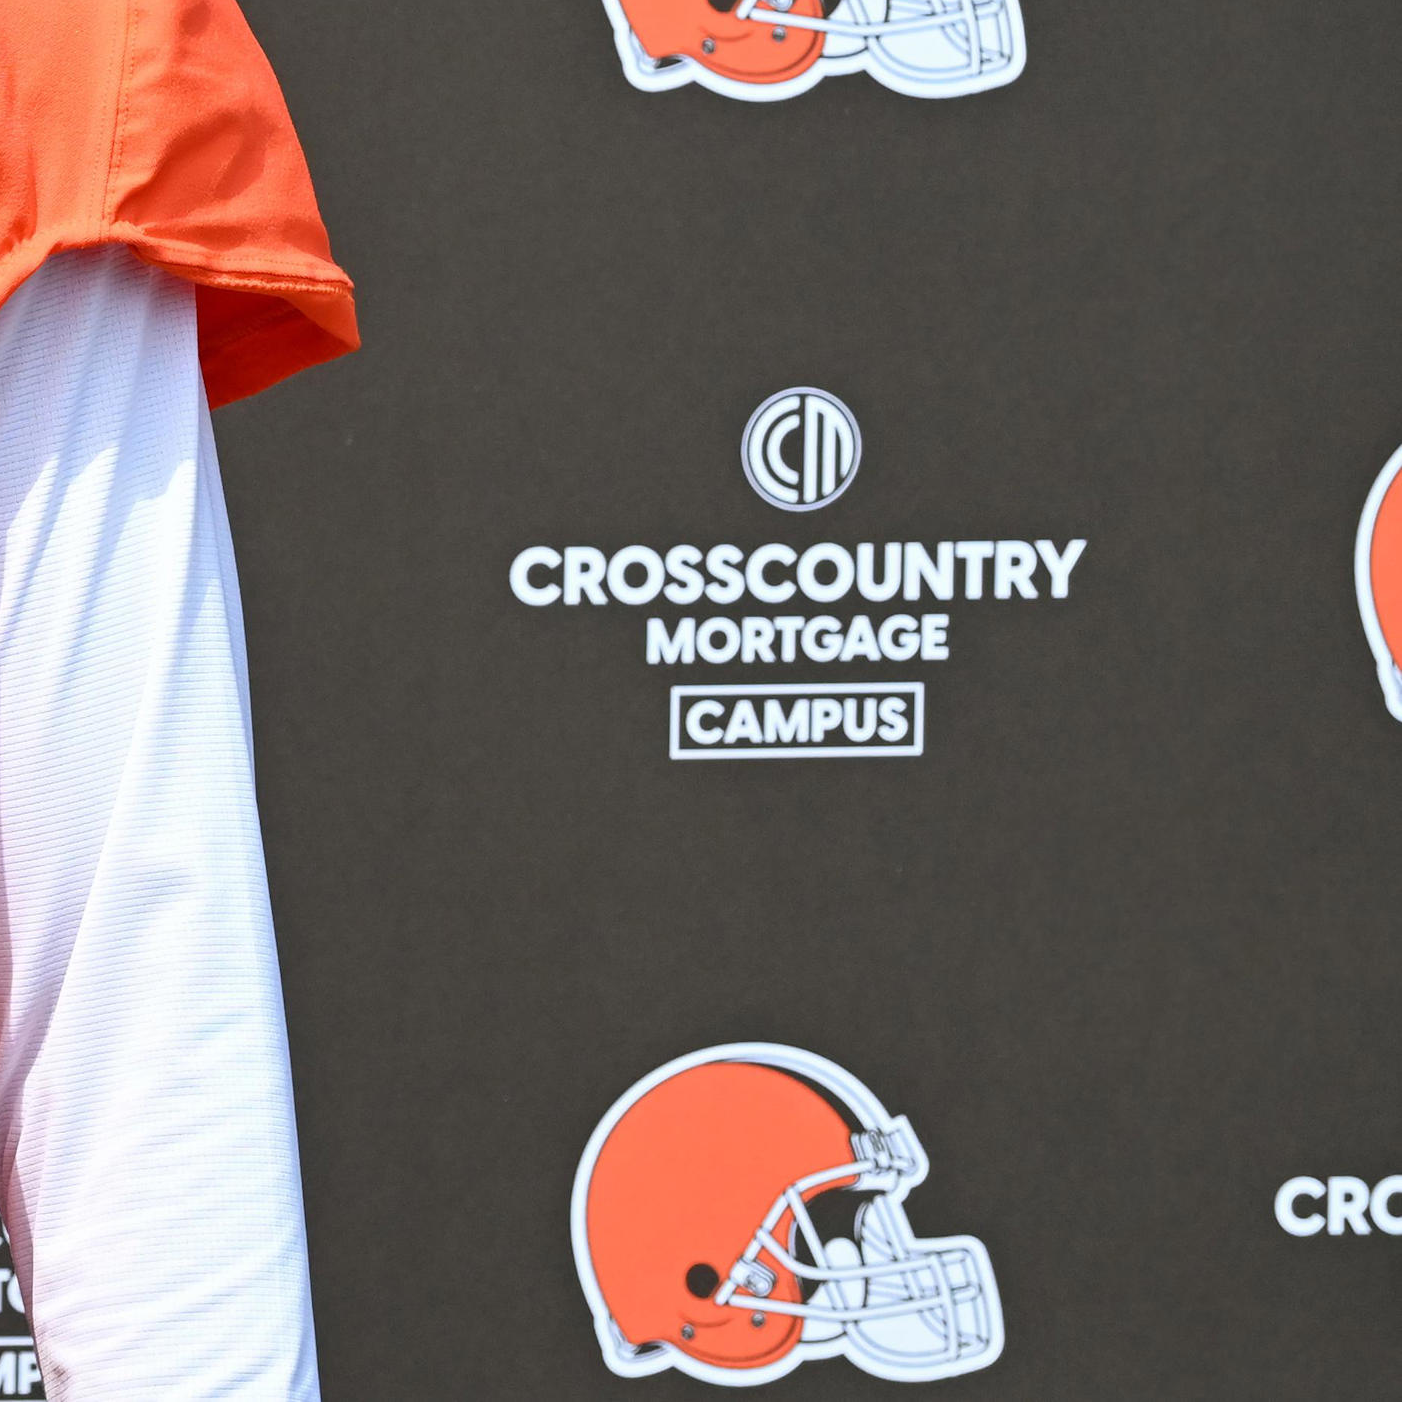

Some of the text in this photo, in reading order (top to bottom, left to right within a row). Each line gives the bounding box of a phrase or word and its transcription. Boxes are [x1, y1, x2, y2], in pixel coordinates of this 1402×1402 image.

[509, 538, 1088, 607] CROSSCOUNTRY
[646, 613, 950, 665] MORTGAGE
[685, 697, 910, 746] CAMPUS
